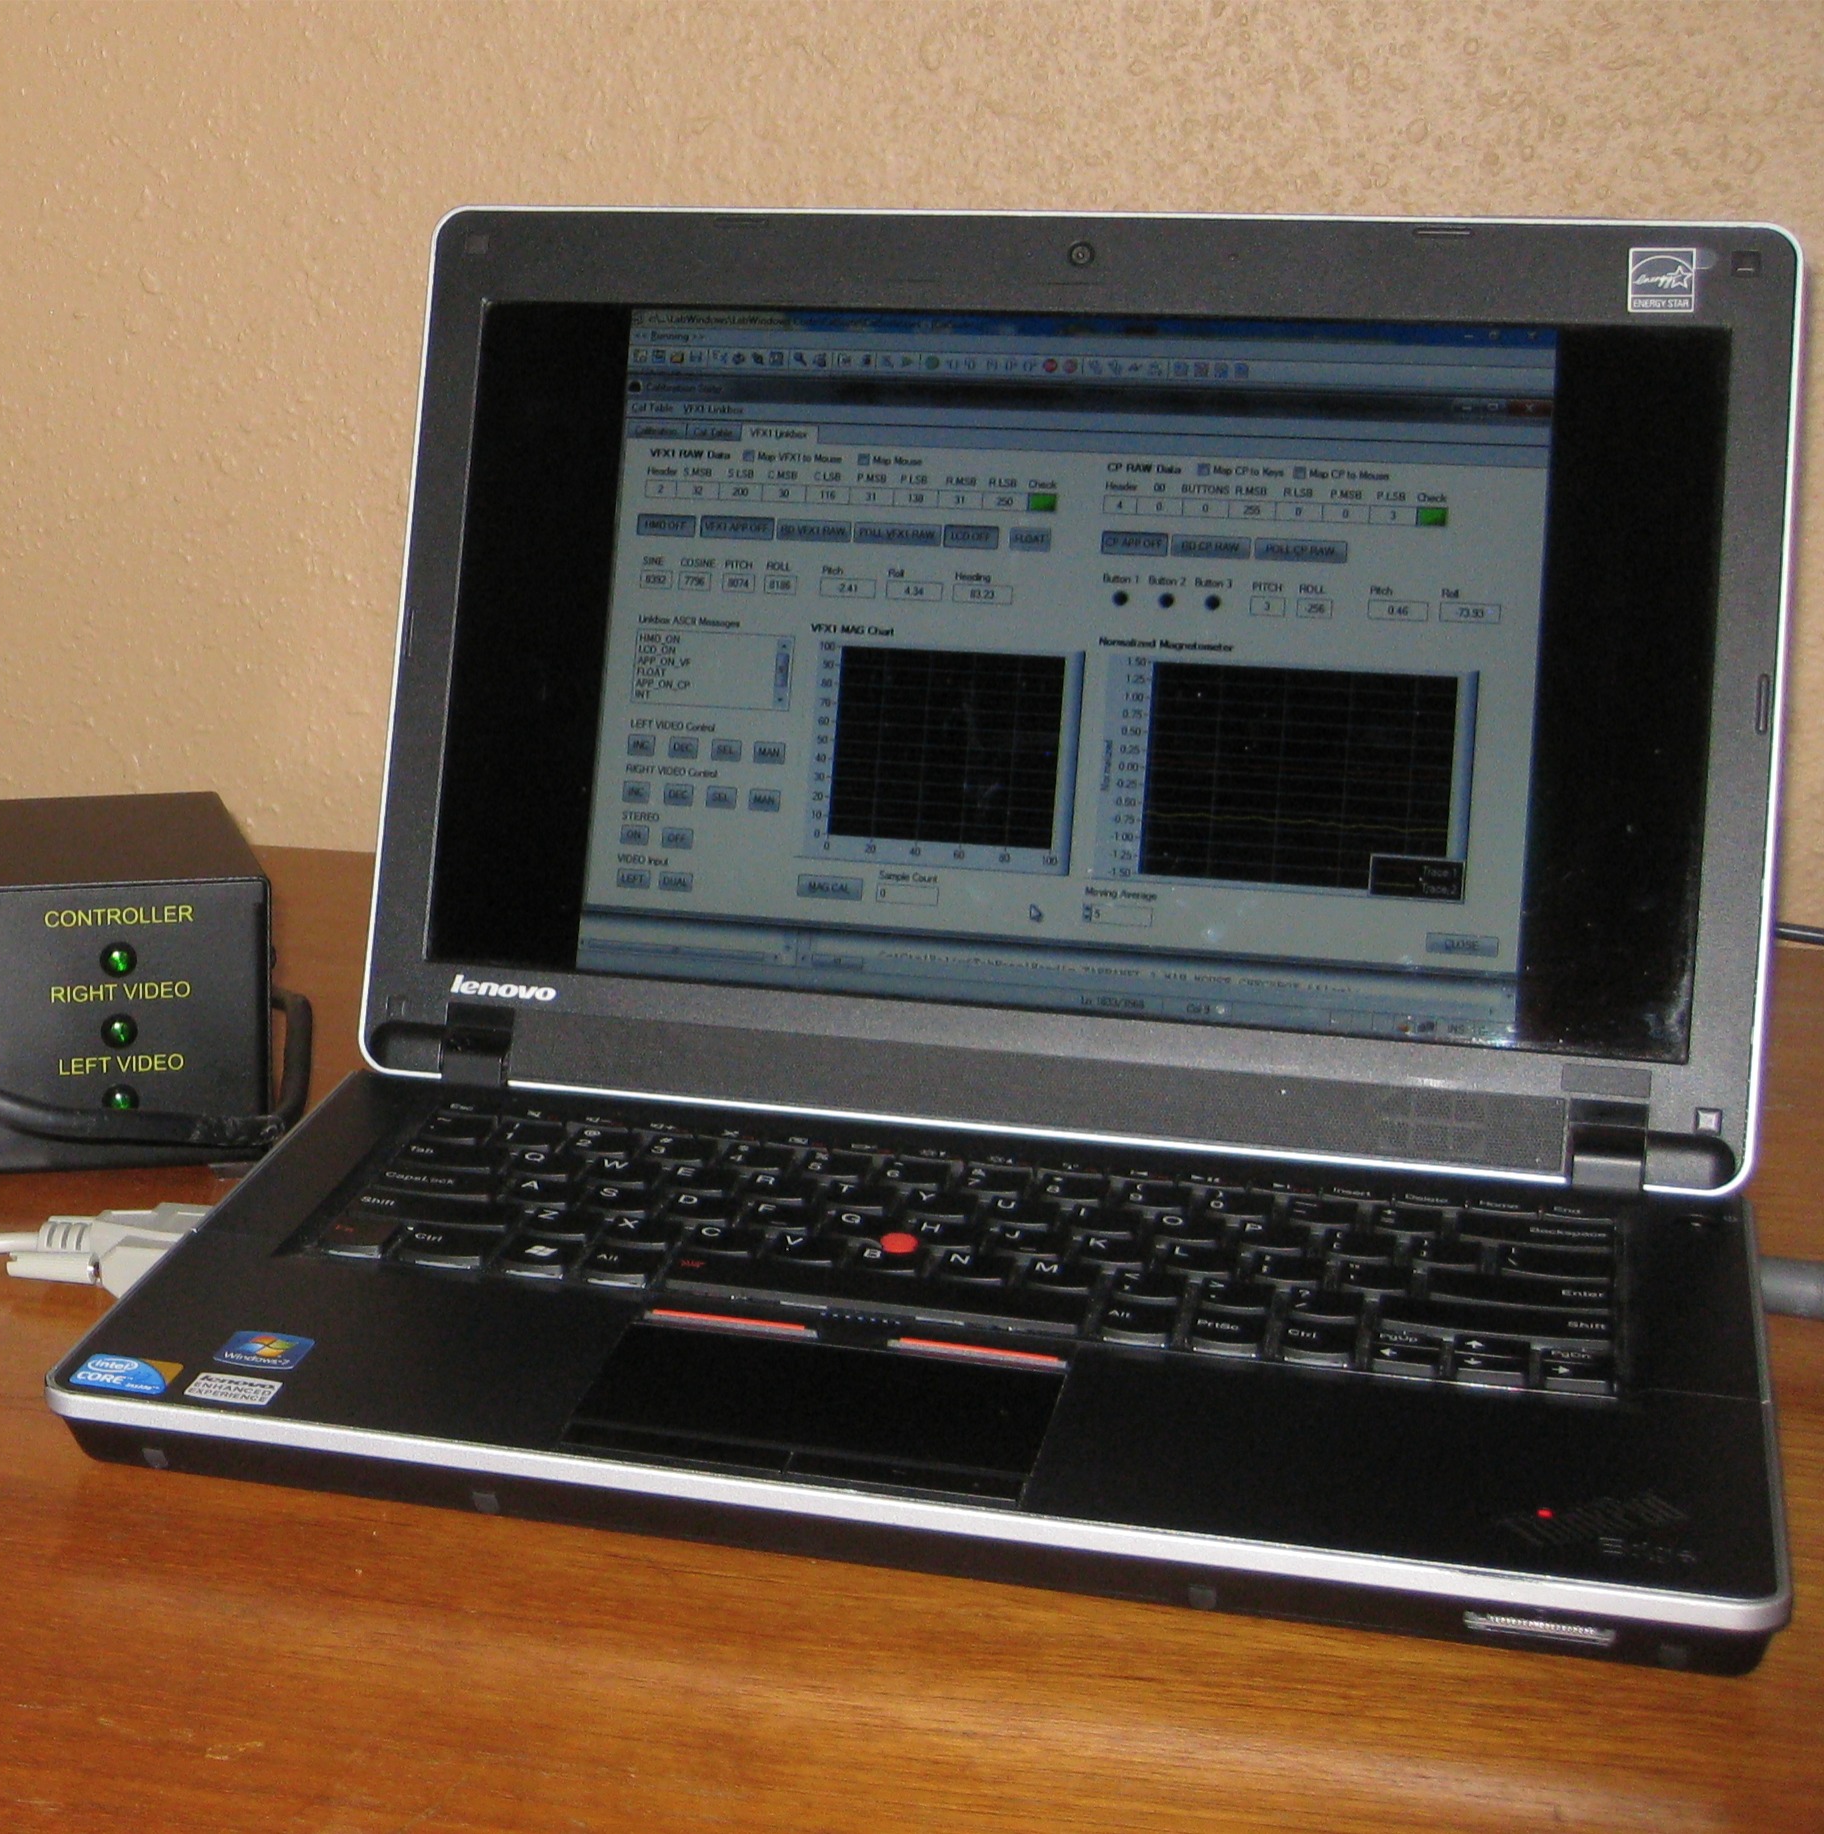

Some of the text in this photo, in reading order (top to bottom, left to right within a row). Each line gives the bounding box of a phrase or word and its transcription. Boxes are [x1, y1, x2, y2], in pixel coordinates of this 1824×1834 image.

[1633, 299, 1690, 308] ENERGY STAR
[650, 449, 731, 460] VFX1 RAW Data
[758, 452, 776, 463] Map
[814, 455, 842, 463] Mouse
[873, 456, 922, 466] Map Mouse
[647, 467, 677, 476] Header
[1107, 463, 1182, 474] CP RAW Data
[1213, 466, 1232, 476] Map
[1263, 469, 1284, 478] Keys
[1309, 469, 1328, 479] Map
[1359, 471, 1389, 480] Mouse
[1028, 480, 1057, 489] Check
[1106, 481, 1137, 491] Header
[1182, 484, 1229, 495] BUTTONS
[1417, 493, 1447, 502] Check
[643, 556, 790, 571] SINE COSINE PITCH ROLL
[822, 566, 991, 582] Pitch Roll Heading
[1103, 573, 1131, 583] Button
[1149, 575, 1177, 584] Button
[1195, 577, 1223, 588] Button
[1252, 581, 1459, 598] PITCH ROLL Pitch Roll
[639, 615, 670, 624] Linkbox
[699, 617, 740, 629] Messages
[811, 623, 894, 636] VFX1 MAG Chart
[1099, 637, 1233, 651] Normalized Magnetometer
[637, 668, 666, 677] FLOAT
[631, 719, 715, 732] LEFT VIDEO Control
[626, 764, 718, 778] RIGHT VIDEO Control
[622, 811, 660, 821] STEREO
[617, 854, 669, 866] VIDEO Input
[879, 870, 938, 883] Sample Count
[1085, 887, 1157, 902] Moving Average
[44, 905, 194, 928] CONTROLLER
[50, 981, 191, 1003] RIGHT VIDEO
[450, 974, 556, 1001] lenovo
[58, 1053, 184, 1076] LEFT VIDEO
[409, 1144, 434, 1155] Tab
[524, 1152, 546, 1162] Q
[603, 1159, 629, 1169] W
[677, 1167, 696, 1177] E
[756, 1174, 776, 1186] R
[838, 1184, 855, 1193] T
[919, 1190, 936, 1201] Y
[997, 1199, 1016, 1210] U
[1162, 1215, 1184, 1226] O
[1529, 1226, 1608, 1238] Backspace
[521, 1180, 540, 1190] A
[600, 1187, 620, 1197] S
[679, 1195, 698, 1204] D
[758, 1203, 777, 1213] F
[841, 1213, 862, 1223] G
[921, 1222, 941, 1233] H
[1005, 1230, 1021, 1239] J
[1089, 1238, 1107, 1248] K
[1174, 1246, 1190, 1256] L
[1561, 1288, 1605, 1299] Enter
[360, 1195, 1607, 1330] Shift Z X C V B N M Shift
[415, 1232, 443, 1243] Ctrl
[597, 1252, 619, 1263] Alt
[1287, 1328, 1317, 1339] Ctrl
[1379, 1332, 1417, 1345] PgUp
[224, 1351, 278, 1364] Windows
[95, 1359, 129, 1370] intel
[77, 1370, 127, 1385] CORE
[188, 1388, 268, 1403] EXPERIENCE
[194, 1381, 273, 1397] ENHANCED
